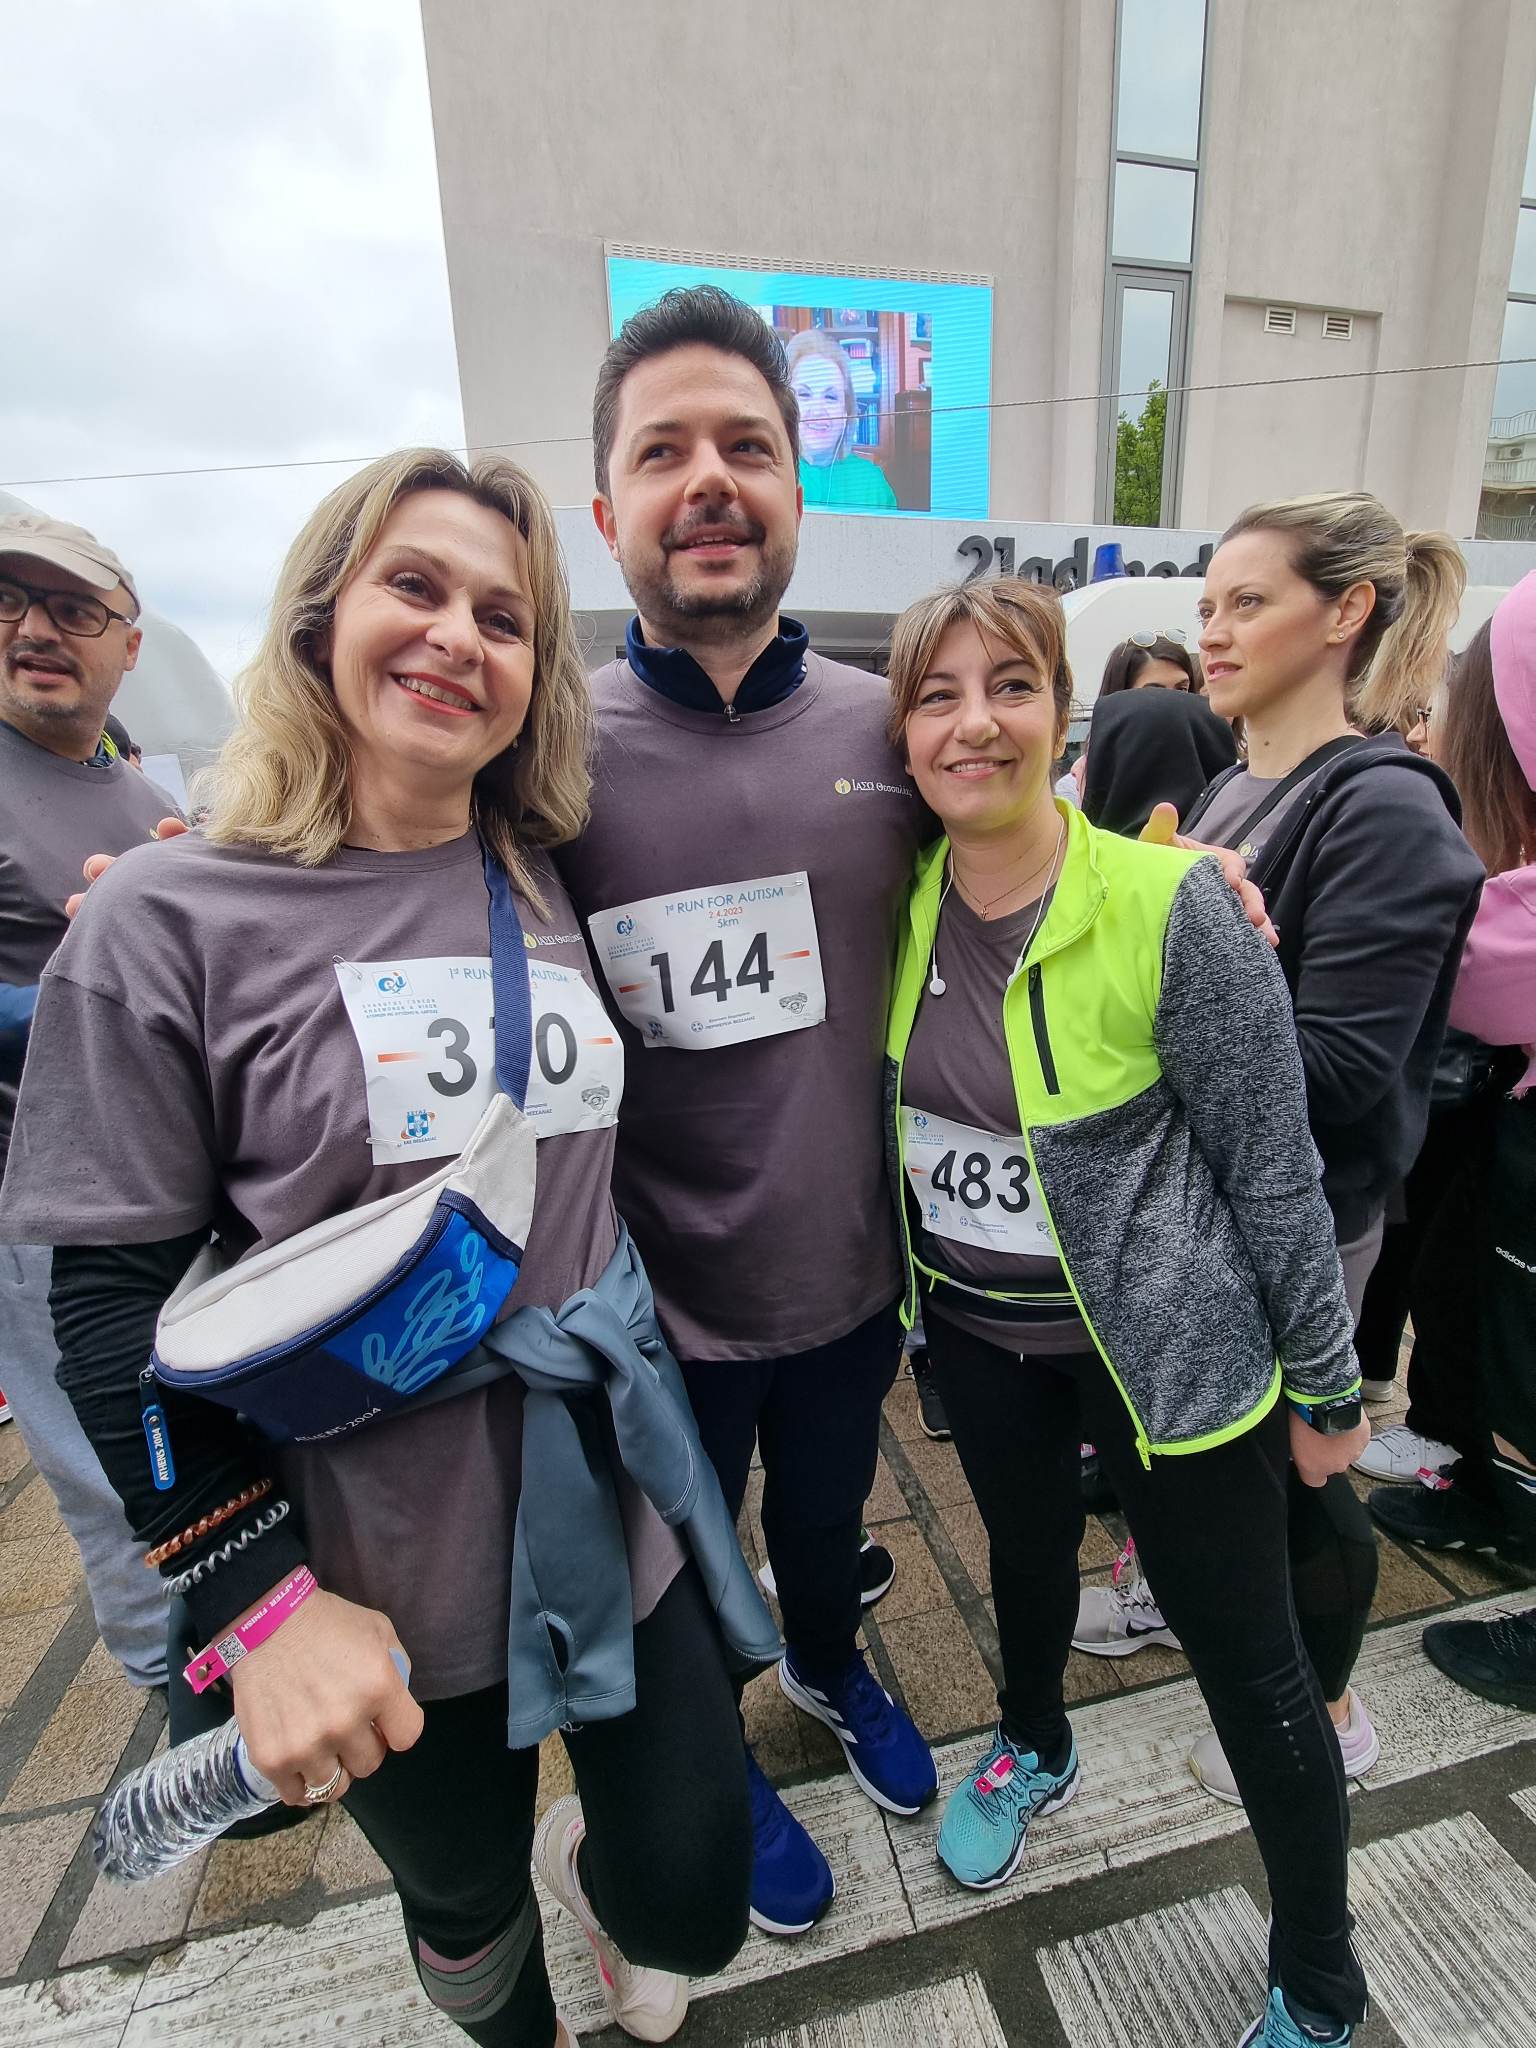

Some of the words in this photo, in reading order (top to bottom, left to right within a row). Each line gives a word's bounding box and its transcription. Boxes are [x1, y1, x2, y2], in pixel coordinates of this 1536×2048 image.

[677, 899, 704, 914] RUN
[707, 894, 734, 908] FOR
[738, 887, 784, 904] AUTISM
[717, 917, 740, 929] 5km
[463, 967, 493, 980] RUN
[650, 931, 775, 1014] 144
[427, 1012, 577, 1097] 30
[930, 1149, 1031, 1214] 483
[1495, 1246, 1526, 1269] adidas
[345, 1407, 381, 1428] 2004
[151, 1427, 164, 1449] 2004
[156, 1448, 169, 1481] ATHENS
[269, 1581, 294, 1608] AFTER
[241, 1606, 269, 1633] FINISH
